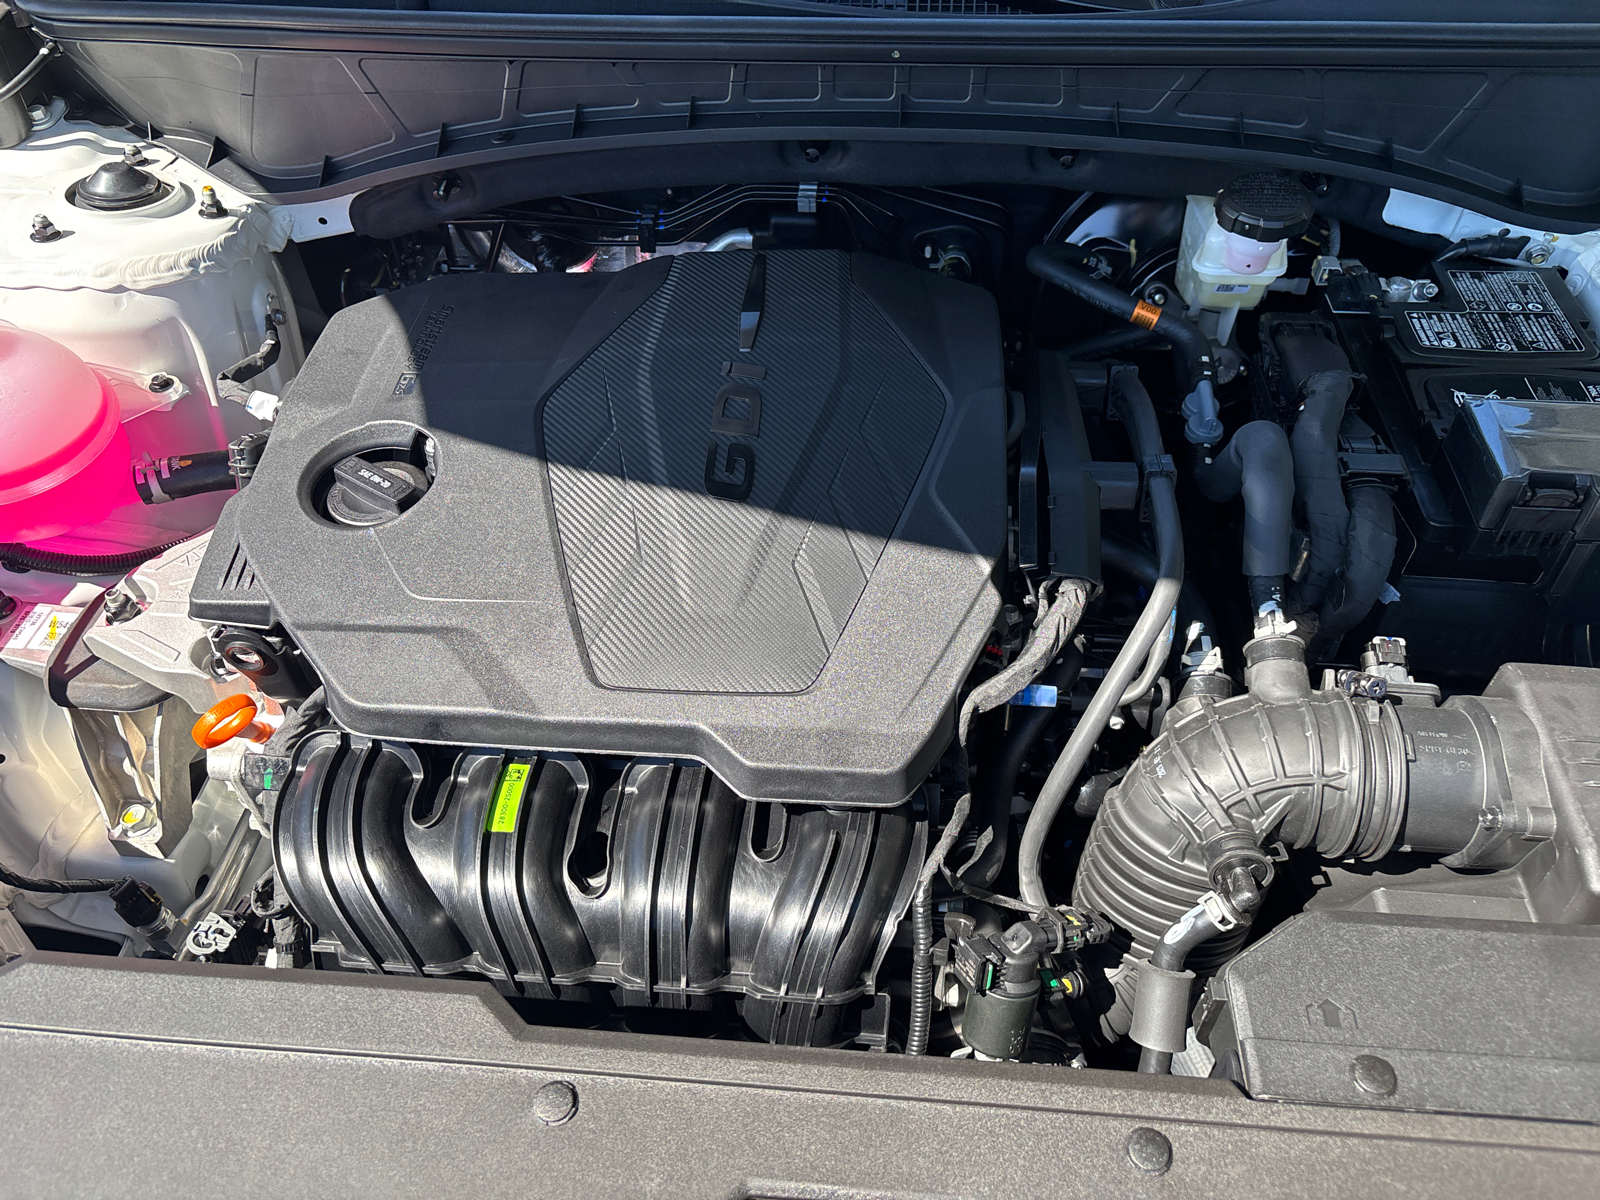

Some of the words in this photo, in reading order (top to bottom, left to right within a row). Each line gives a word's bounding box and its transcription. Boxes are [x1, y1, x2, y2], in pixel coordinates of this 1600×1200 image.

[405, 311, 439, 370] TECHNOLOGY
[413, 303, 455, 371] Smartstream
[357, 469, 373, 479] SAE
